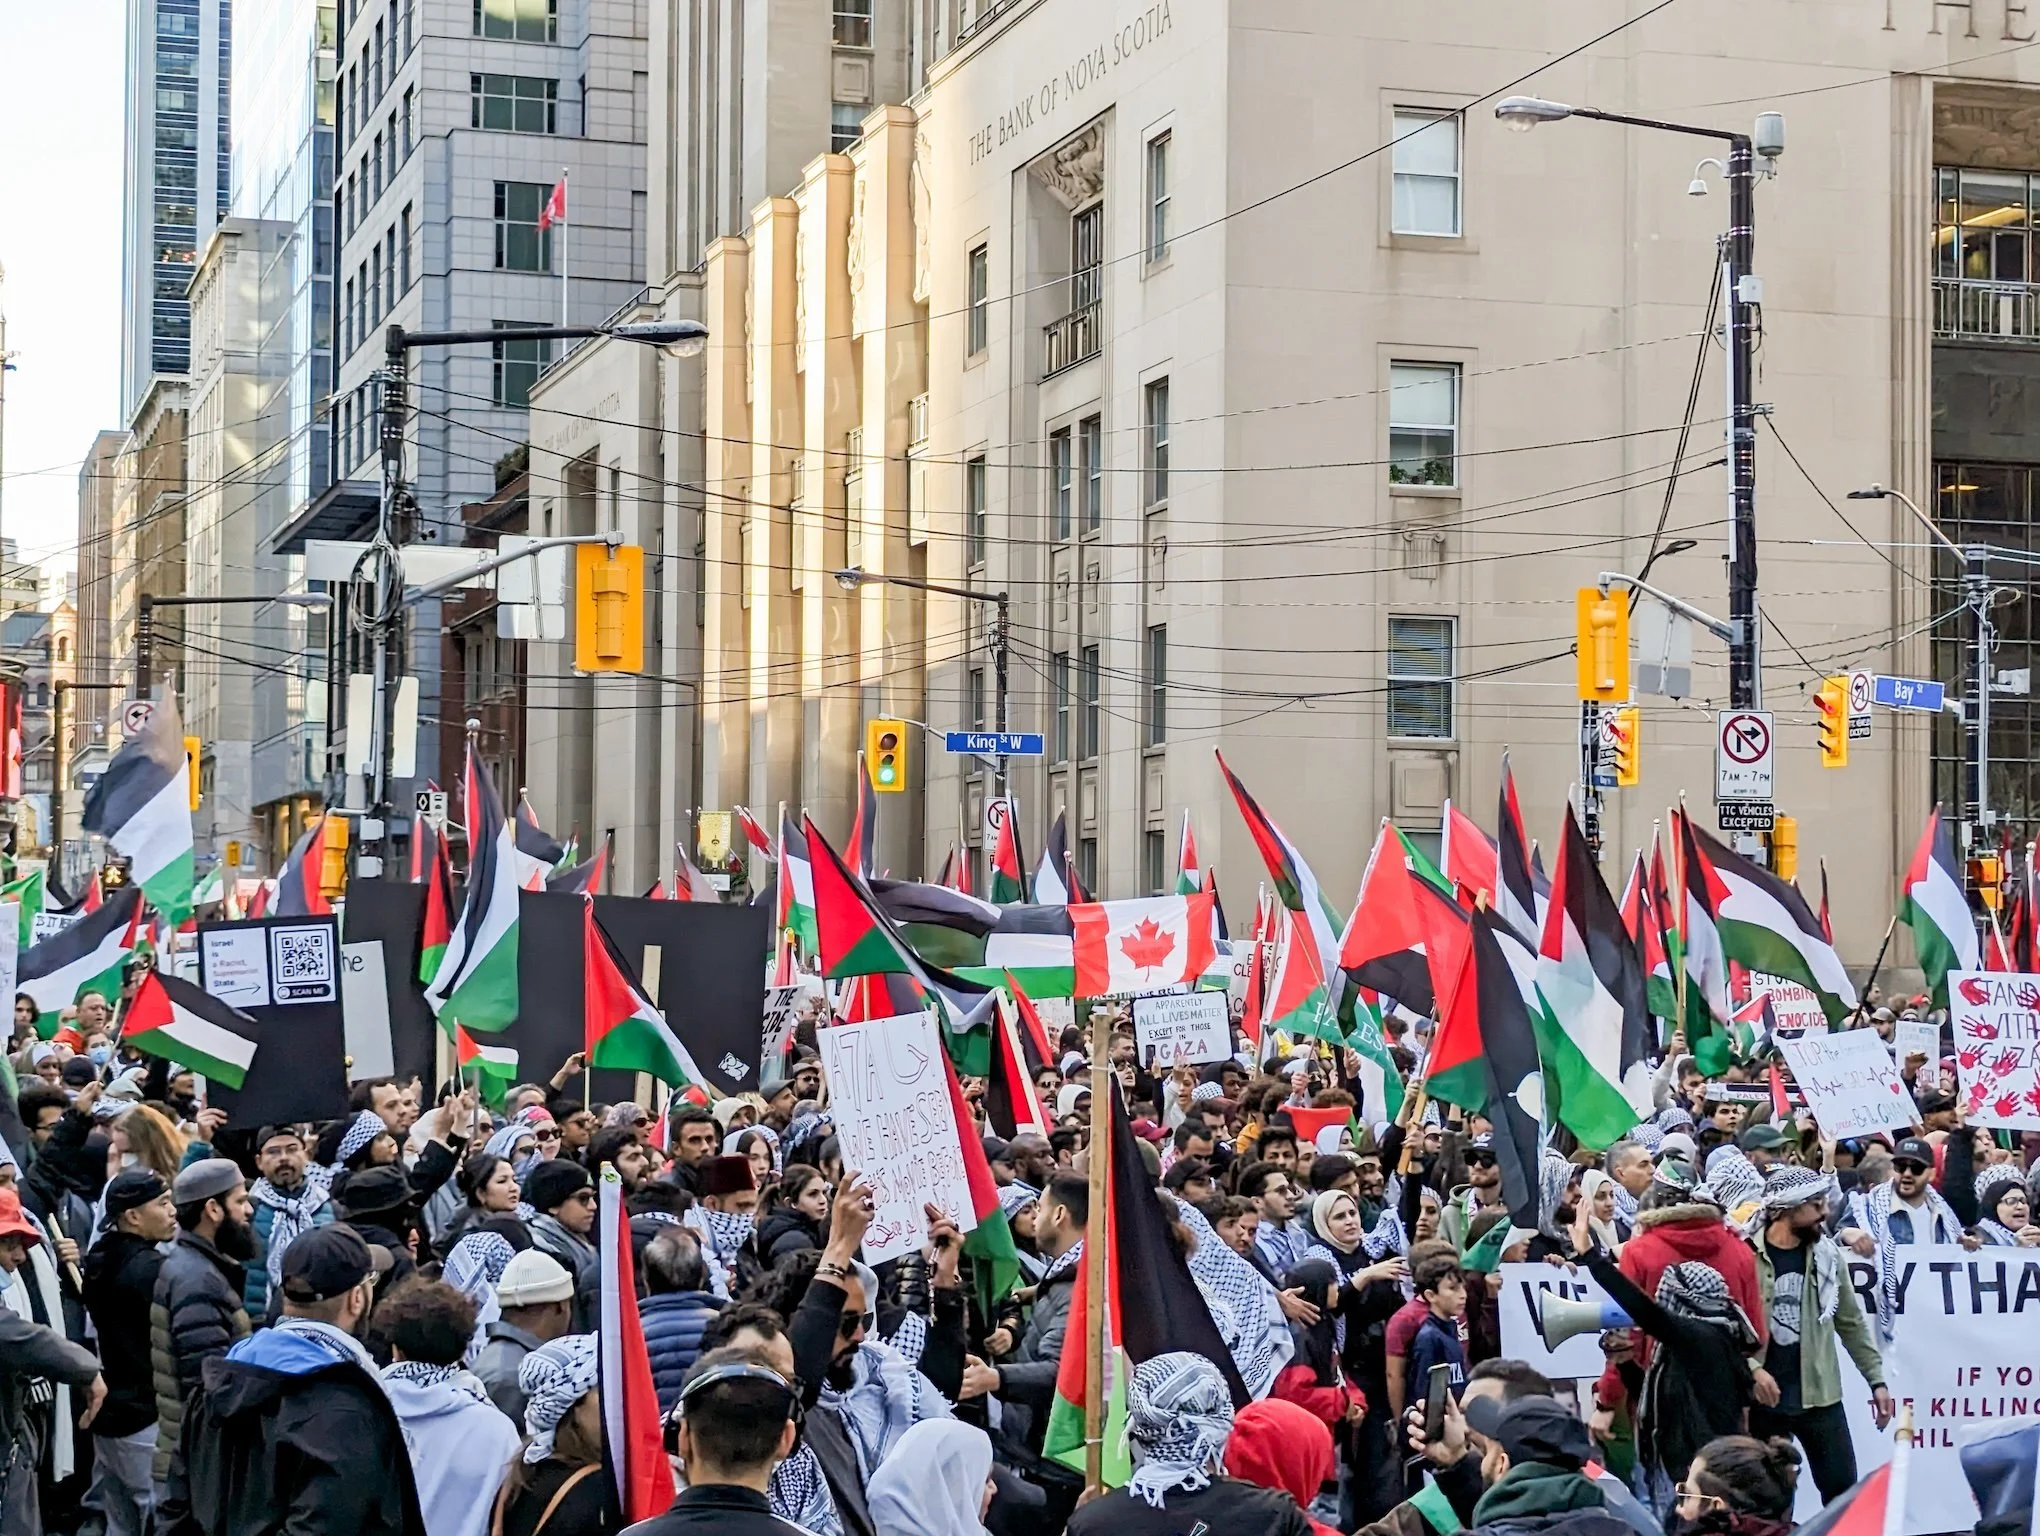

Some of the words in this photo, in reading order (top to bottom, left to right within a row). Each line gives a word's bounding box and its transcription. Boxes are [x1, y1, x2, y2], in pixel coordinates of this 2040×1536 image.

[968, 125, 994, 167] THE
[999, 96, 1035, 147] BANK
[1039, 78, 1059, 116] OF
[1065, 44, 1108, 102] NOVA
[1113, 0, 1173, 67] SCOTIA
[1894, 680, 1914, 705] Bay
[1916, 683, 1924, 694] St
[967, 734, 997, 752] King
[1000, 735, 1008, 743] St
[1010, 735, 1022, 749] W
[1720, 805, 1736, 816] TTC
[1738, 806, 1773, 816] VEHICLES
[1722, 817, 1771, 827] EXCEPTED
[211, 939, 234, 948] Israel
[291, 987, 312, 997] SCAN
[312, 986, 325, 996] ME
[774, 987, 798, 1008] THE
[1768, 986, 1815, 1002] BOMBIN
[1154, 997, 1204, 1011] APPARENTLY
[1138, 1012, 1159, 1027] ALL
[1162, 1009, 1190, 1024] LIVES
[1190, 1006, 1222, 1021] MATTER
[1776, 1011, 1828, 1028] ENOCIDE
[1148, 1026, 1173, 1039] EXCEPT
[1175, 1025, 1186, 1034] FOR
[1190, 1022, 1212, 1032] THOSE
[1178, 1033, 1187, 1041] IN
[1160, 1038, 1208, 1060] GAZA
[831, 1028, 884, 1113] A7A
[840, 1117, 876, 1169] WE
[876, 1103, 920, 1161] HAVE
[916, 1082, 952, 1145] SEEN
[1957, 1366, 1982, 1387] IF
[1997, 1366, 2040, 1387] YO
